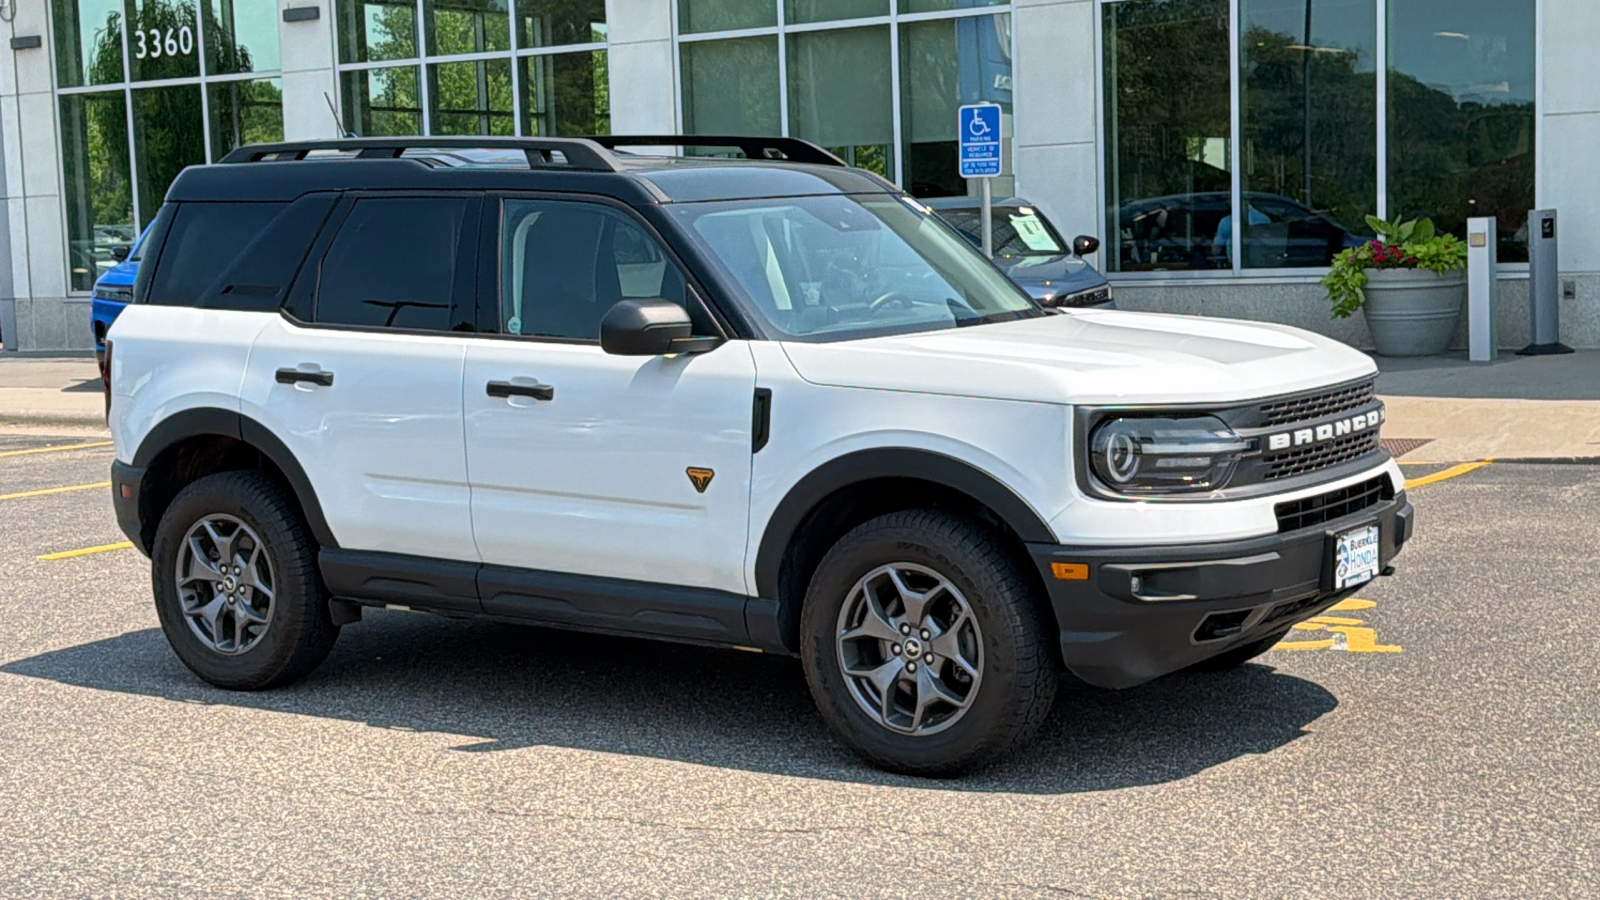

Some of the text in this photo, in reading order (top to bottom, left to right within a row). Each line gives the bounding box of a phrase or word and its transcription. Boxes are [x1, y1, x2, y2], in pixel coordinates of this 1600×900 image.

[134, 25, 193, 59] 3360
[1269, 410, 1379, 451] BRONCO
[1350, 548, 1378, 571] HONDA
